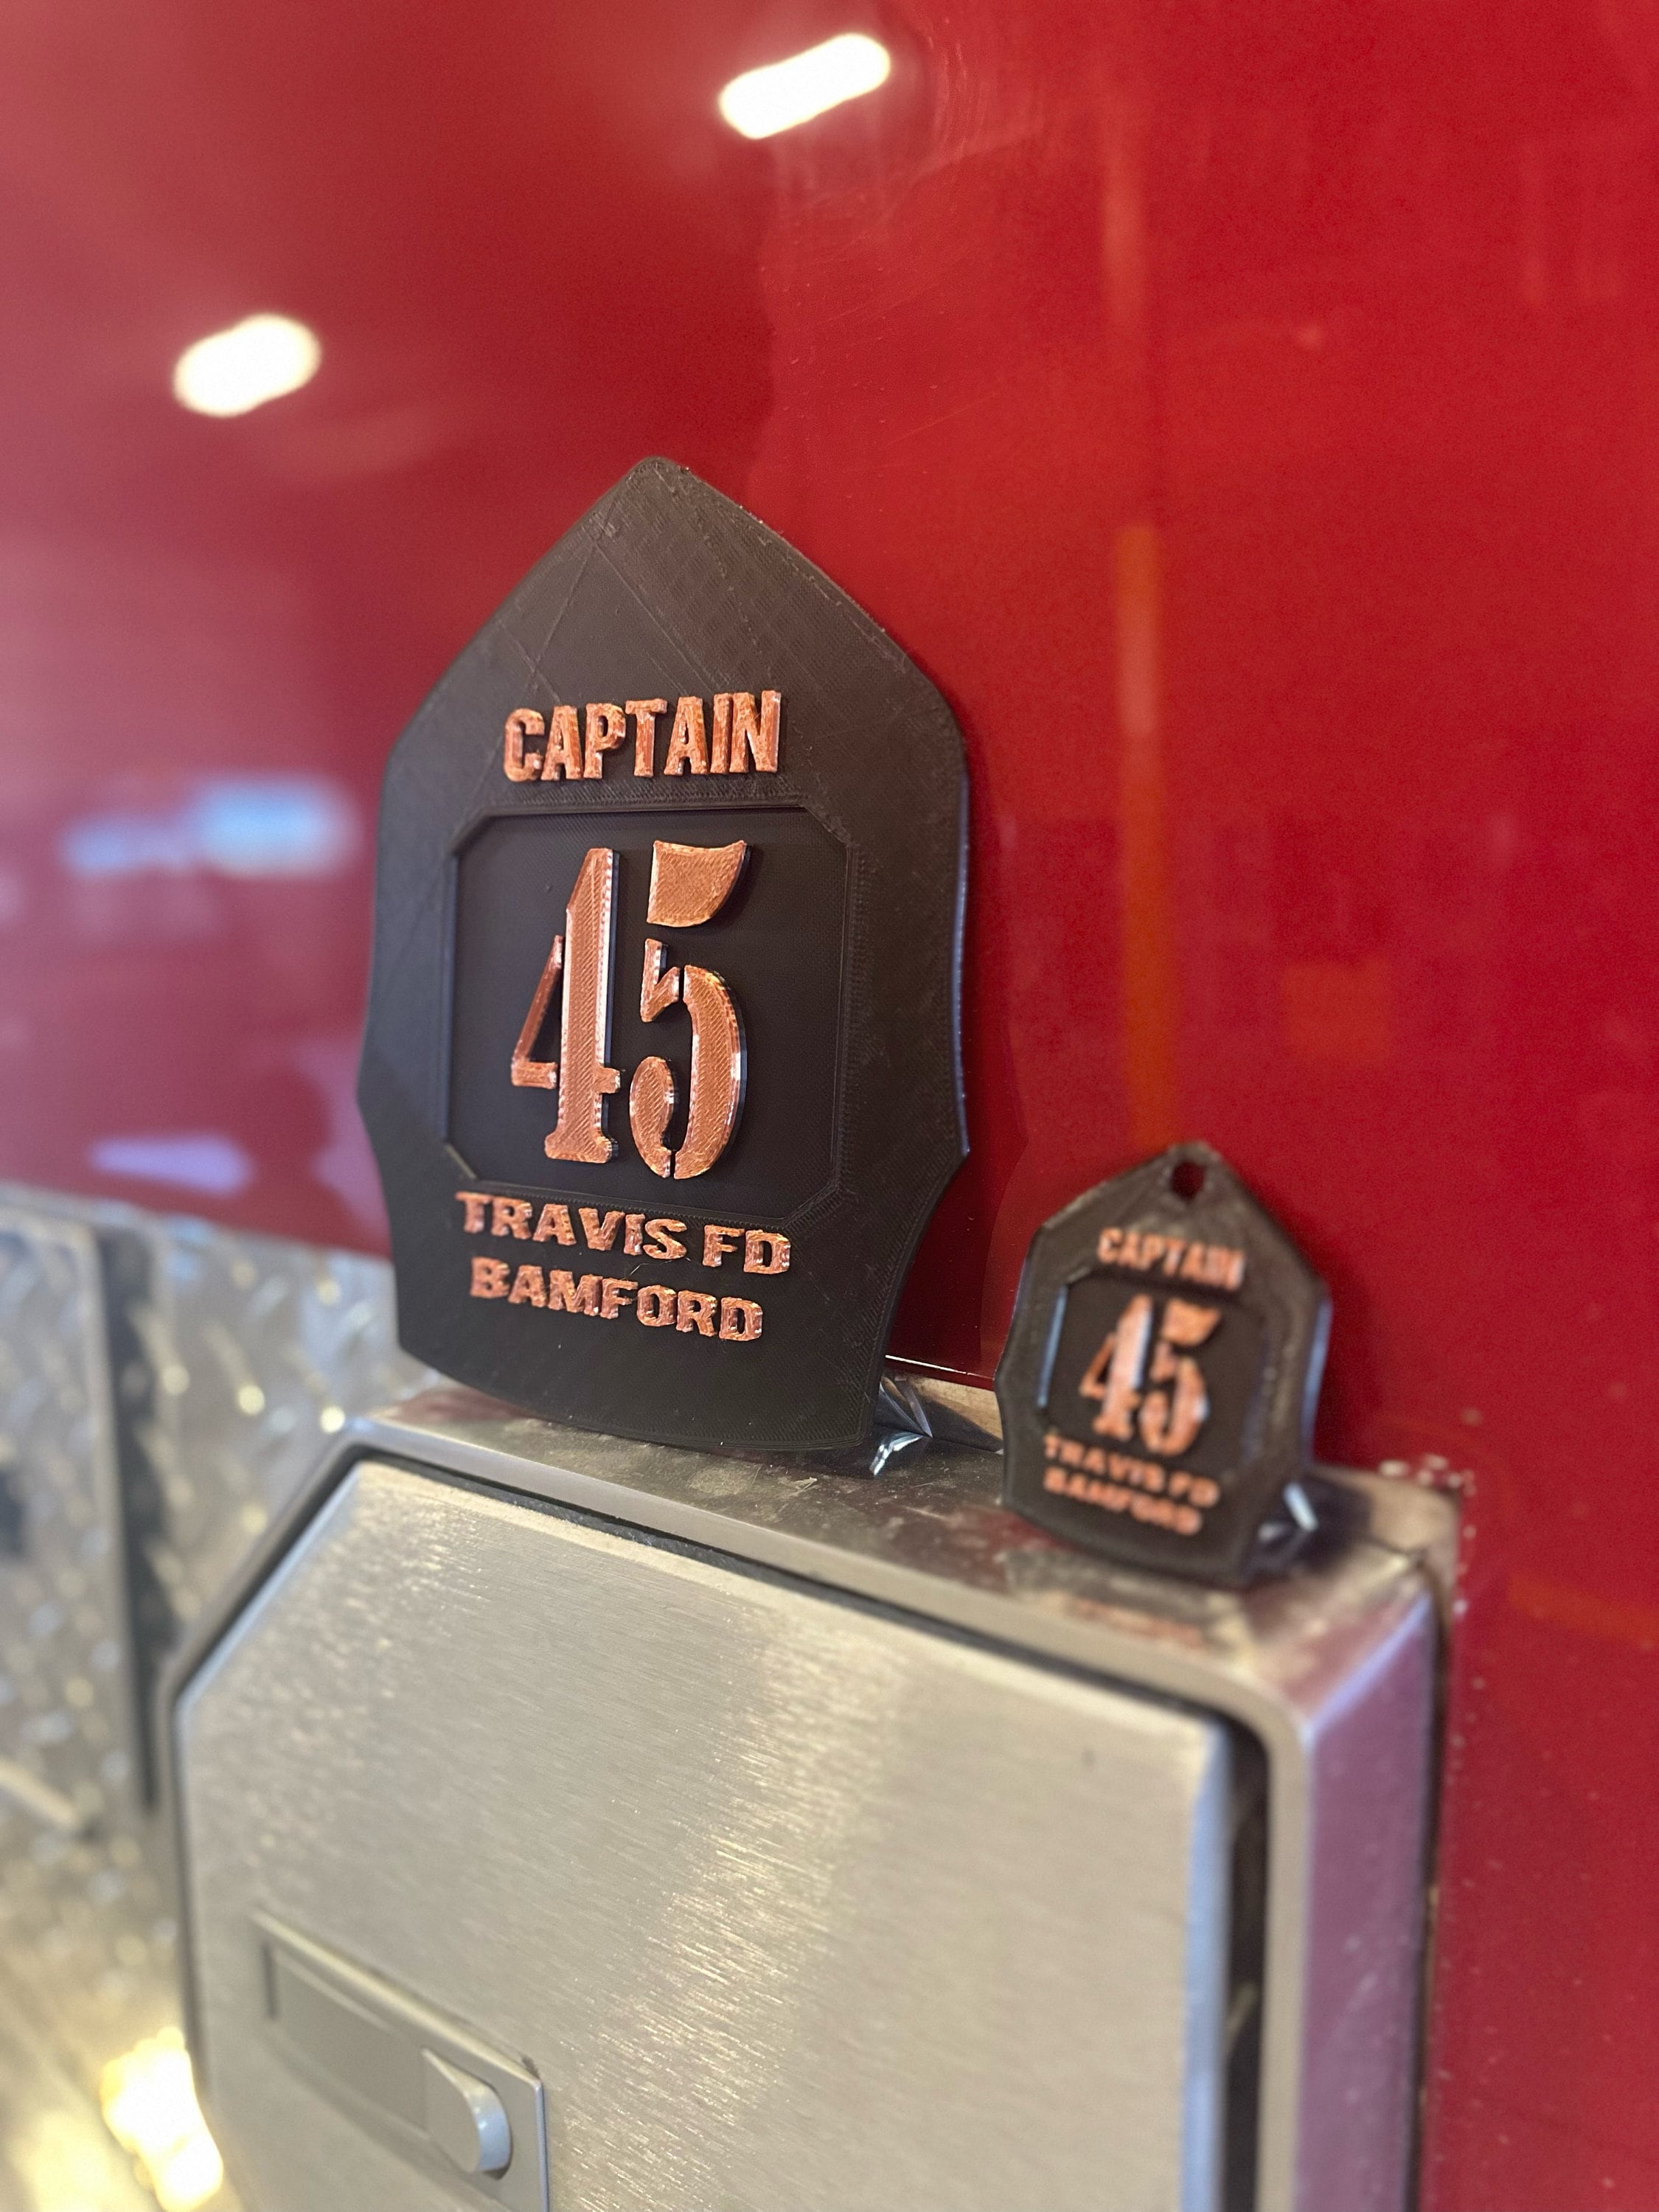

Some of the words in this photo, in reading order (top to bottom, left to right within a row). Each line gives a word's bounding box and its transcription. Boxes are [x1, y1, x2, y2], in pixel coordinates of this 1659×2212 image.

[503, 691, 782, 782] CAPTAIN
[511, 839, 748, 1179] 45
[456, 1191, 687, 1261] TRAVIS
[702, 1224, 790, 1275] FD
[1098, 1228, 1244, 1289] CAPTAIN
[469, 1256, 764, 1341] BAMFORD
[1079, 1294, 1222, 1455] 45
